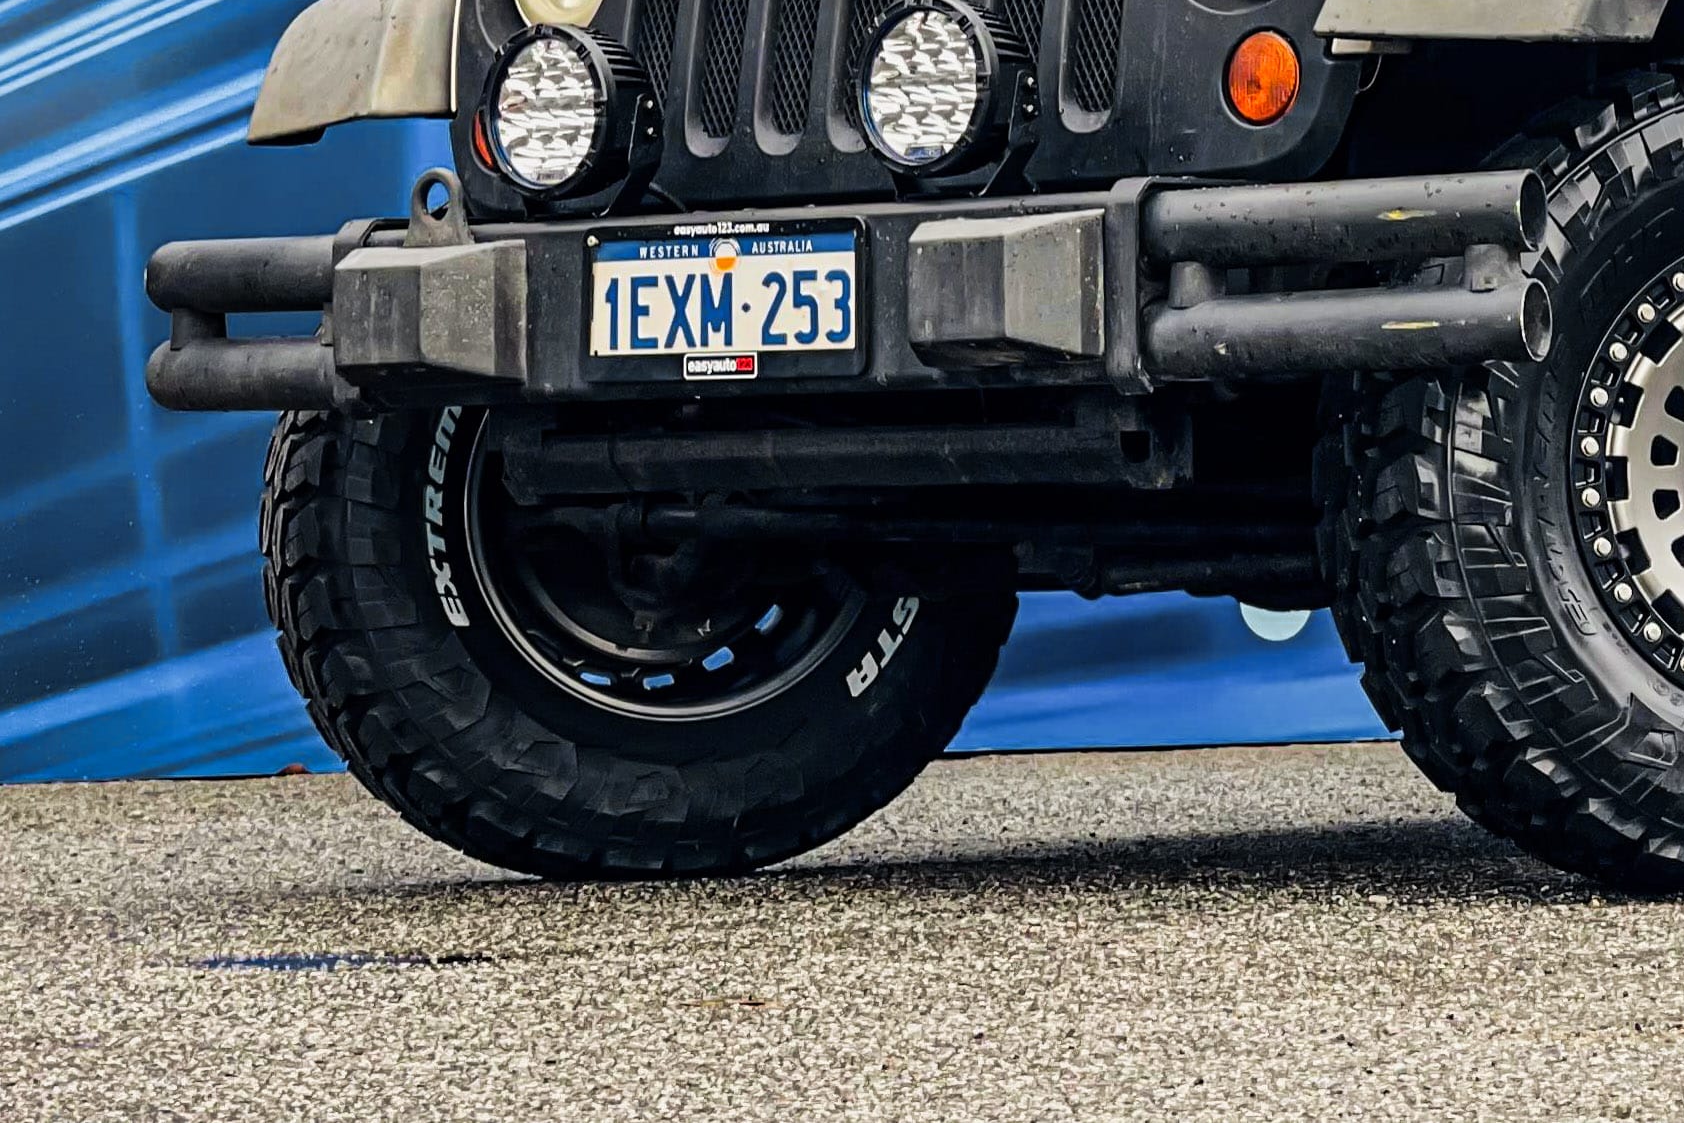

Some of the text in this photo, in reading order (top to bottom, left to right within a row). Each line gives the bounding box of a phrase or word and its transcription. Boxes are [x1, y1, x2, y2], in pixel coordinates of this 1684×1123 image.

[673, 221, 770, 238] easyauto123.com.au
[639, 239, 813, 259] WESTERN AUSTRALIA
[687, 356, 754, 375] easyauto123
